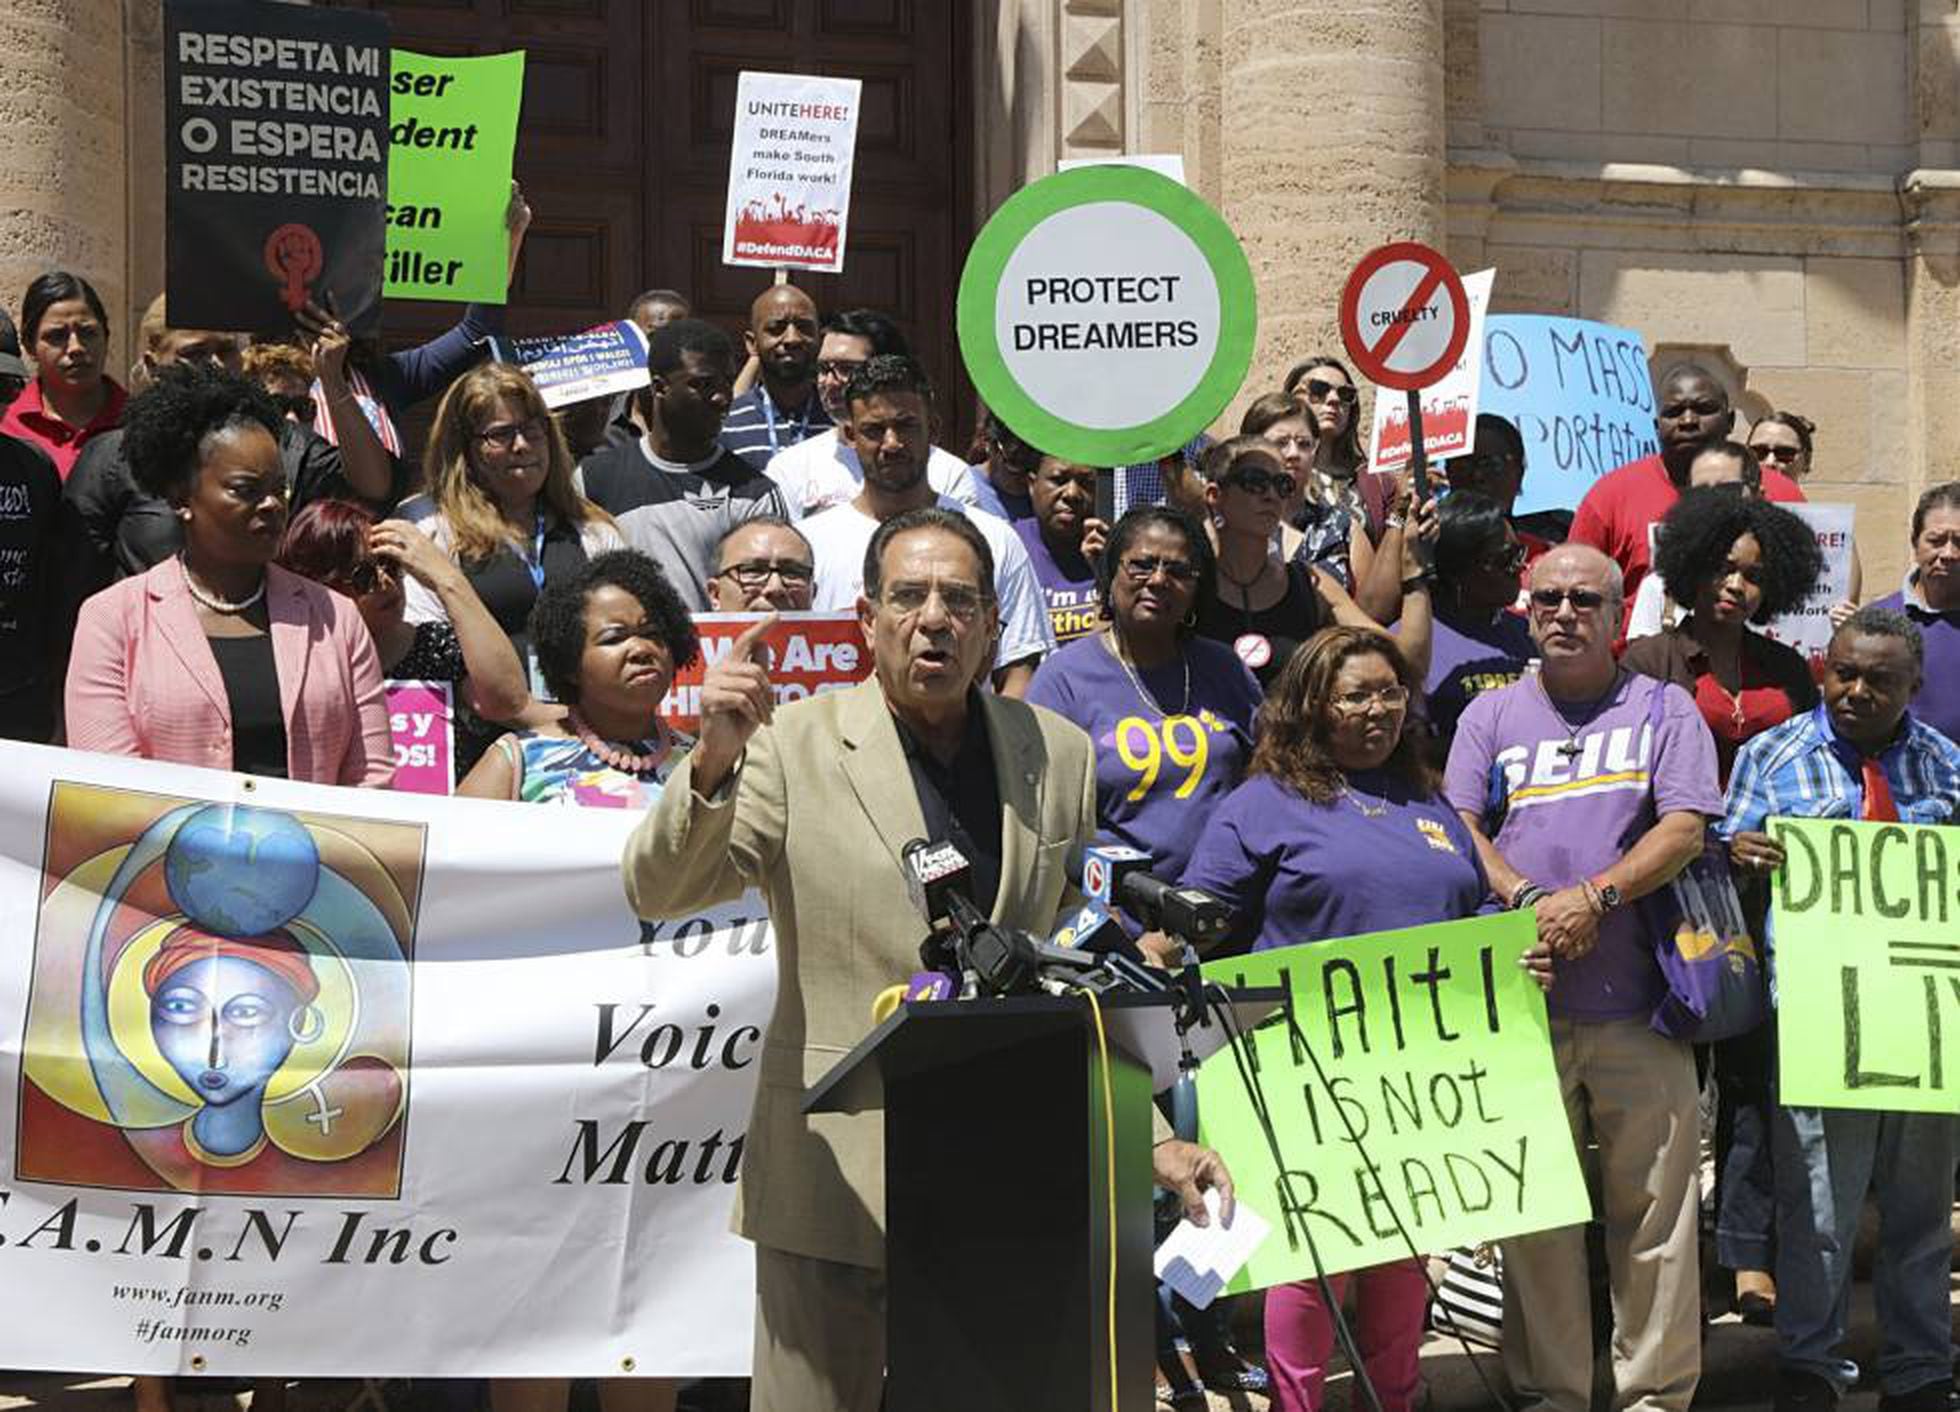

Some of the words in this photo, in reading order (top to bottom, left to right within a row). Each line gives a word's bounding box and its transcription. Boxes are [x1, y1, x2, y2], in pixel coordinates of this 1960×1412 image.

[179, 32, 339, 74] RESPETA
[345, 45, 380, 77] MI
[181, 75, 381, 117] EXISTENCIA
[181, 117, 218, 153] O
[231, 119, 381, 163] ESPERA
[760, 127, 831, 143] DREAMers
[753, 150, 790, 161] make
[795, 151, 835, 163] South
[181, 163, 380, 198] RESISTENCIA
[747, 169, 793, 181] Florida
[798, 172, 837, 184] work!
[736, 241, 833, 258] #DefendDACA
[1027, 276, 1181, 304] PROTECT
[1371, 305, 1439, 326] CRUELTY
[1014, 320, 1198, 350] DREAMERS
[1550, 327, 1653, 414] MASS
[781, 635, 858, 672] Are
[1116, 707, 1225, 801] 99%
[1775, 822, 1960, 923] DACA
[593, 1003, 760, 1070] Voic
[1275, 1136, 1528, 1252] READY
[320, 1211, 457, 1264] Inc
[112, 1285, 285, 1312] www.fanm.org
[136, 1318, 252, 1347] #fanmorg
